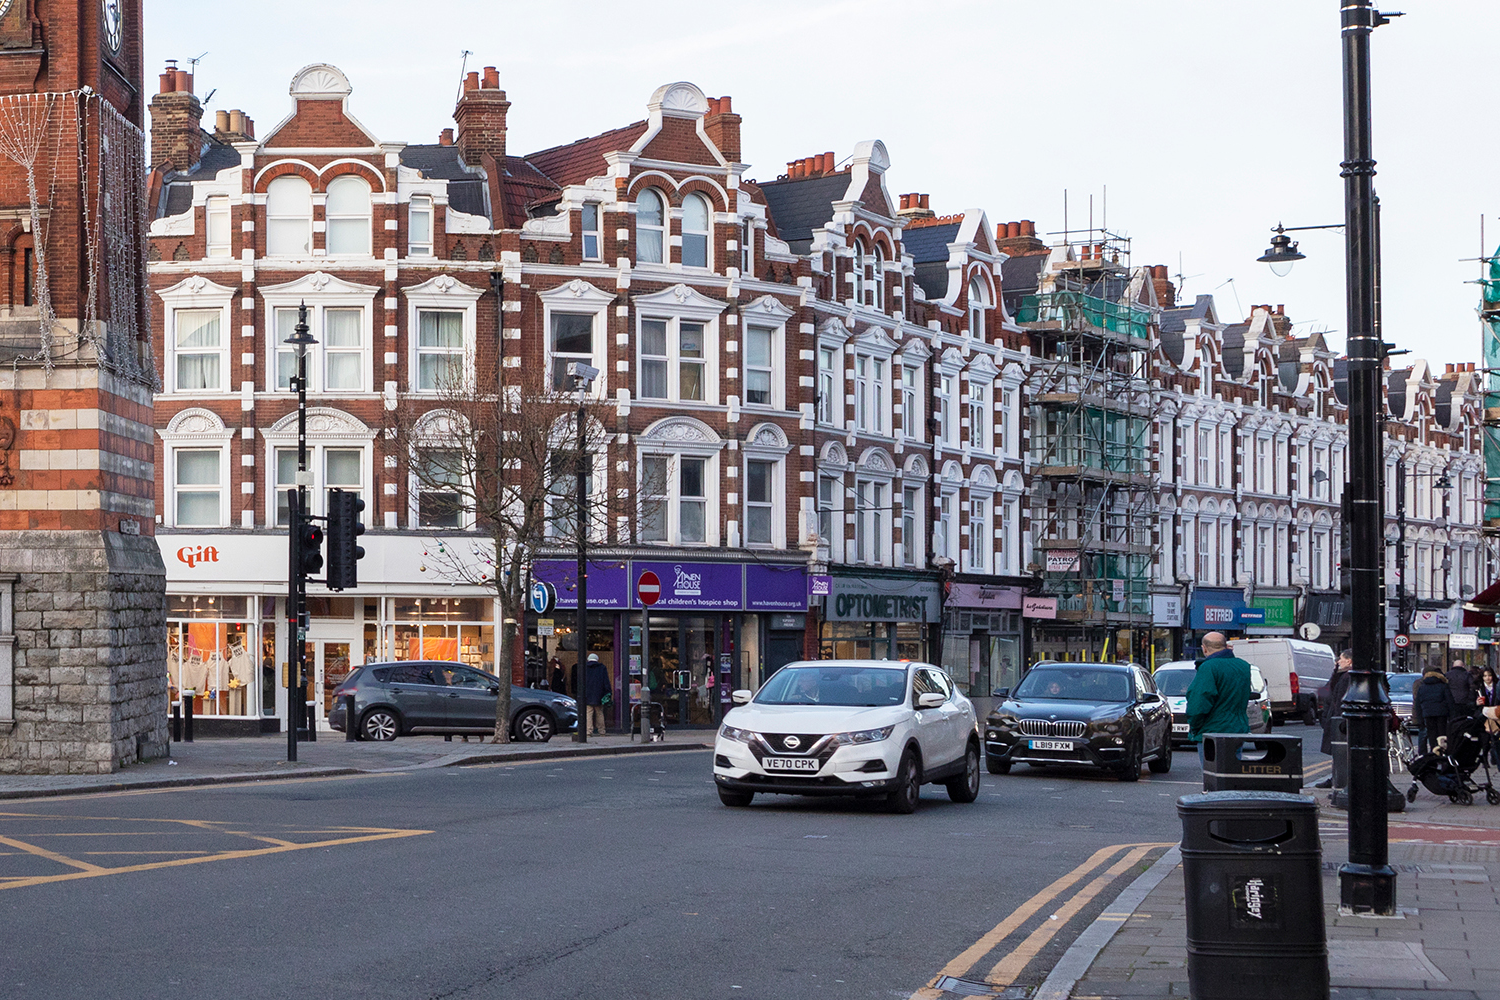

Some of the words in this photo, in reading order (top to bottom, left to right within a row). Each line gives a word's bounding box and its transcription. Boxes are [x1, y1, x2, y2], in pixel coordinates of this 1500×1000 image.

[176, 545, 220, 568] Gift
[677, 580, 700, 589] HOUSE
[723, 599, 738, 607] shop
[752, 600, 801, 608] www.havenhouse.org.uk
[836, 593, 928, 619] OPTOMETRIST
[1205, 608, 1234, 622] BETFRED
[767, 759, 792, 768] VE70
[795, 760, 814, 768] CPK
[1242, 765, 1281, 774] LITTER
[1247, 879, 1264, 919] Haringey
